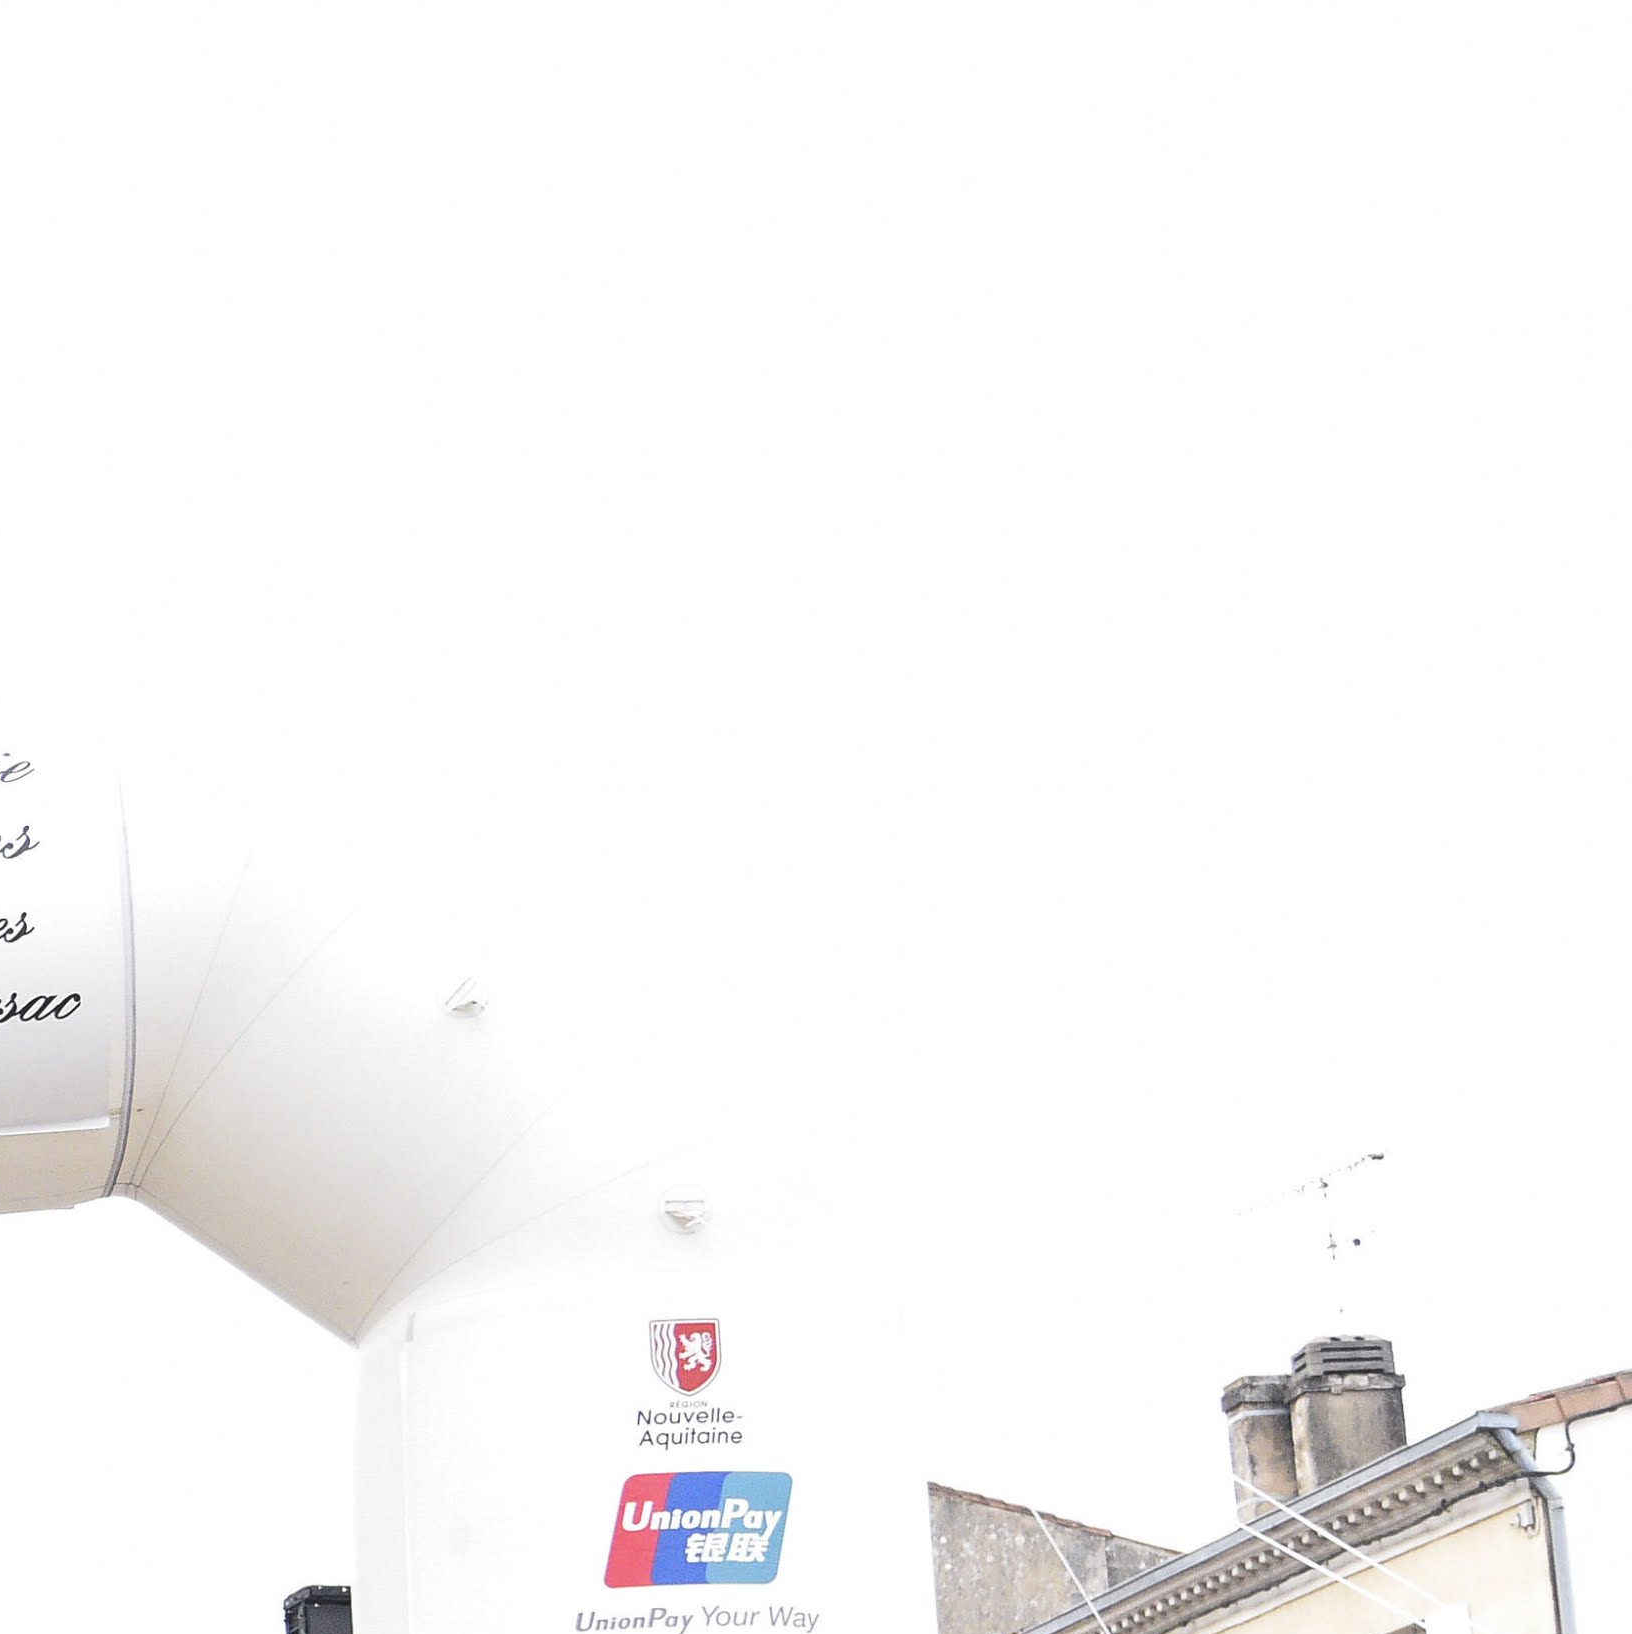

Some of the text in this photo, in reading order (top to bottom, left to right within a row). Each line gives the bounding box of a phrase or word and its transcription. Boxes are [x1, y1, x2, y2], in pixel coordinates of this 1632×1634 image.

[636, 1407, 743, 1426] Nouvelle-
[639, 1427, 743, 1451] Aquitaine
[621, 1497, 783, 1539] UnionPay
[684, 1532, 768, 1564] 银联
[701, 1605, 762, 1628] Your
[768, 1606, 821, 1633] Way
